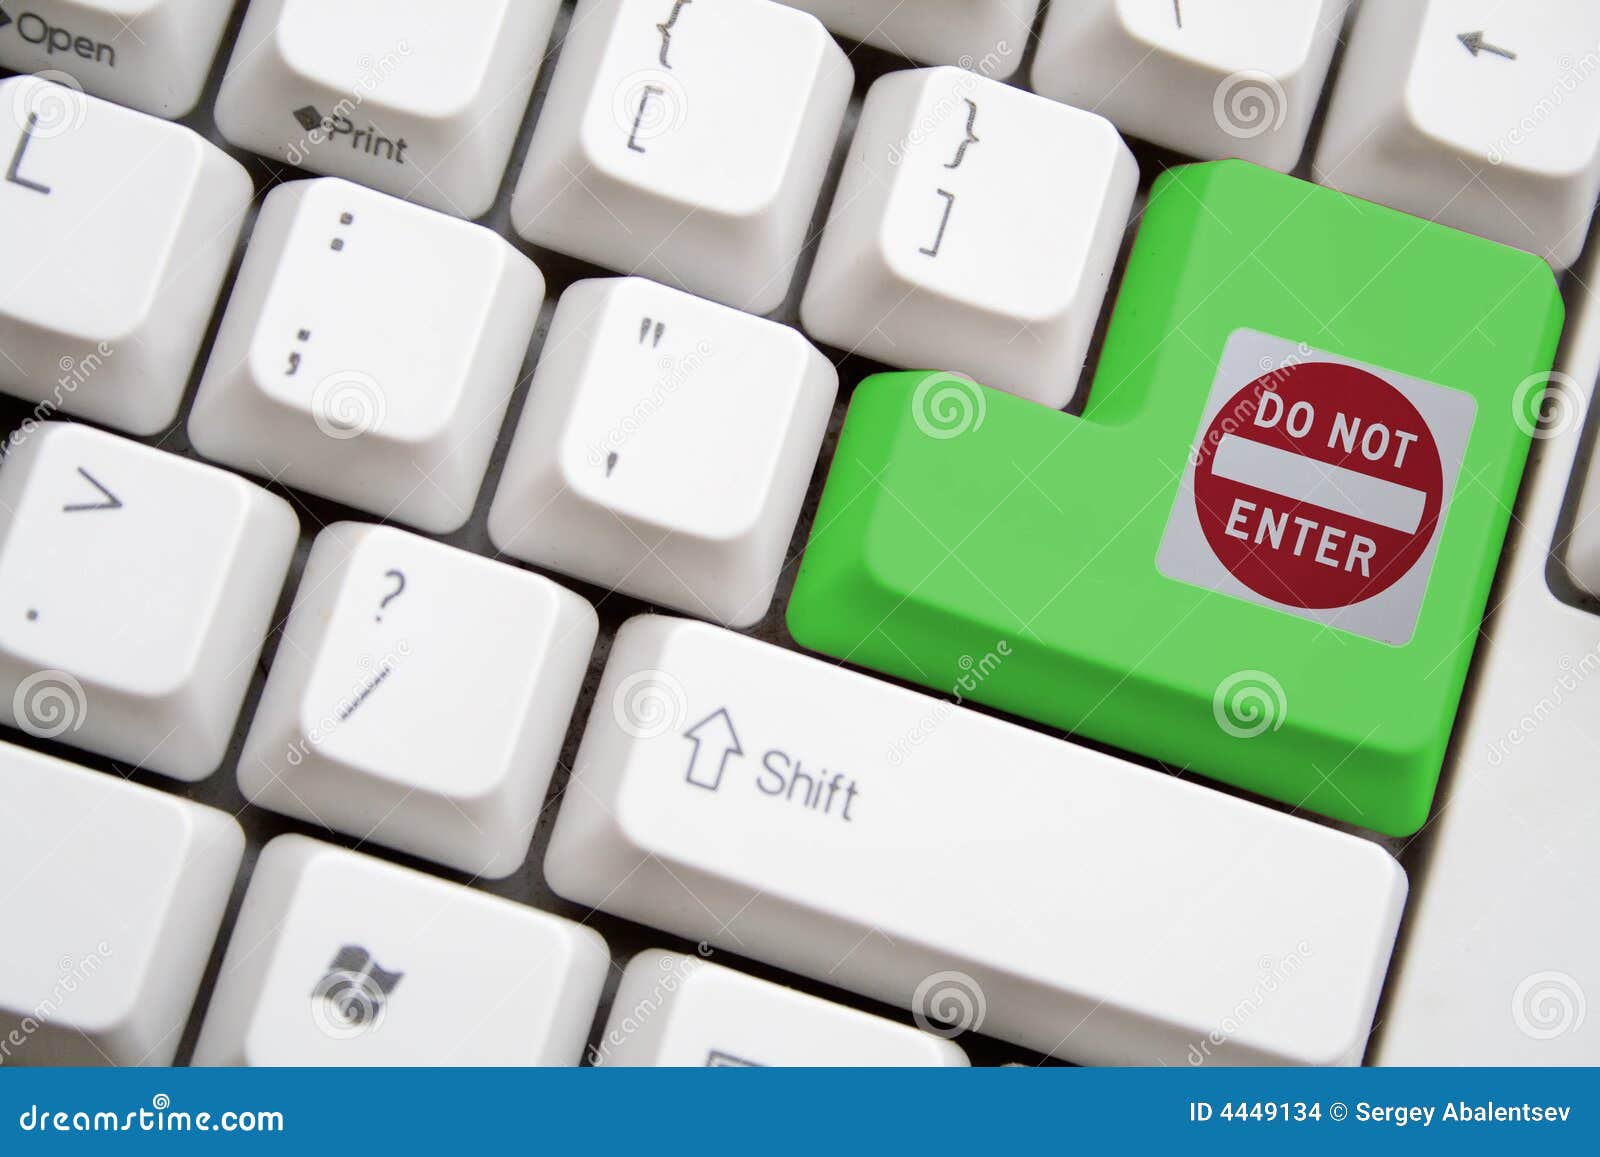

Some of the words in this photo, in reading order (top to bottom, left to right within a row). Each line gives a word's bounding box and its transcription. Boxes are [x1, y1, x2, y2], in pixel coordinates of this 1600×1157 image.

[16, 12, 117, 68] Open
[4, 111, 51, 195] L
[327, 113, 408, 164] Print
[1253, 390, 1315, 438] DO
[1326, 411, 1418, 468] NOT
[1224, 497, 1377, 578] ENTER
[372, 568, 406, 623] ?
[755, 749, 860, 822] Shift
